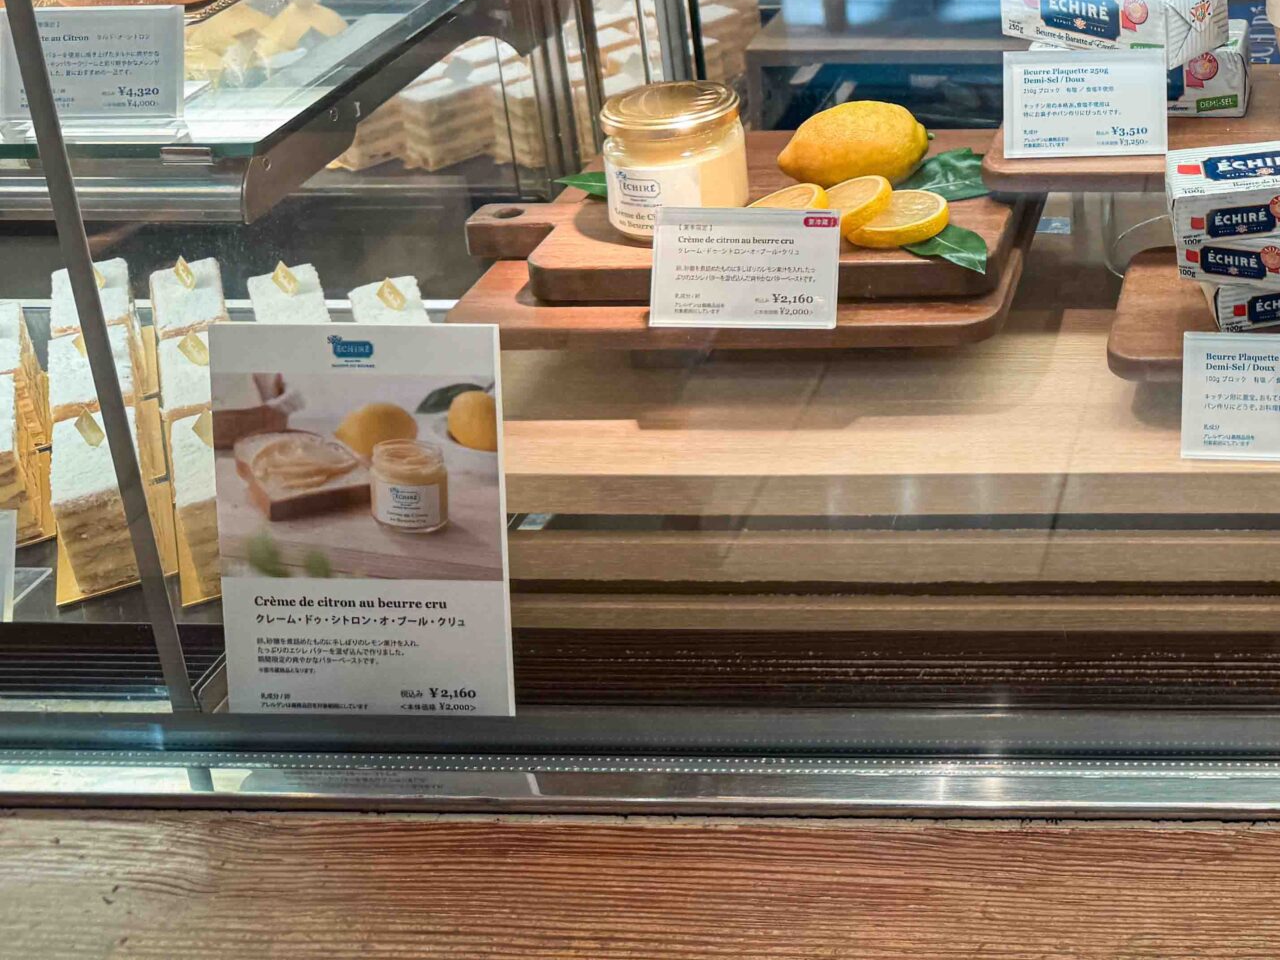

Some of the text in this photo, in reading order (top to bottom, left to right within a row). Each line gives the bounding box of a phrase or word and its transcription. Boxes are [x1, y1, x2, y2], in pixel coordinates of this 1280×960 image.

[1024, 76, 1059, 84] Demi-Sel
[118, 86, 159, 96] ¥4,320
[1200, 97, 1233, 109] DEMI-SEL
[1112, 127, 1148, 136] ¥3,510
[623, 183, 656, 193] ÉCHIRÉ
[1214, 208, 1268, 226] ÉCHIRÉ
[678, 236, 704, 244] Crème
[1208, 250, 1258, 268] ÉCHIRÉ
[772, 294, 813, 304] ¥2,160
[336, 342, 370, 352] ÉCHIRÉ
[1206, 353, 1236, 361] Beurre
[1238, 353, 1279, 362] Plaquette
[1206, 363, 1275, 371] Demi-Sel Doux
[254, 596, 447, 609] Crème de citron au beurre cru
[256, 614, 466, 627] クレーム・ドゥ・シトロン・オ・ブール・クリュ
[401, 688, 476, 699] 税込み ¥2,160
